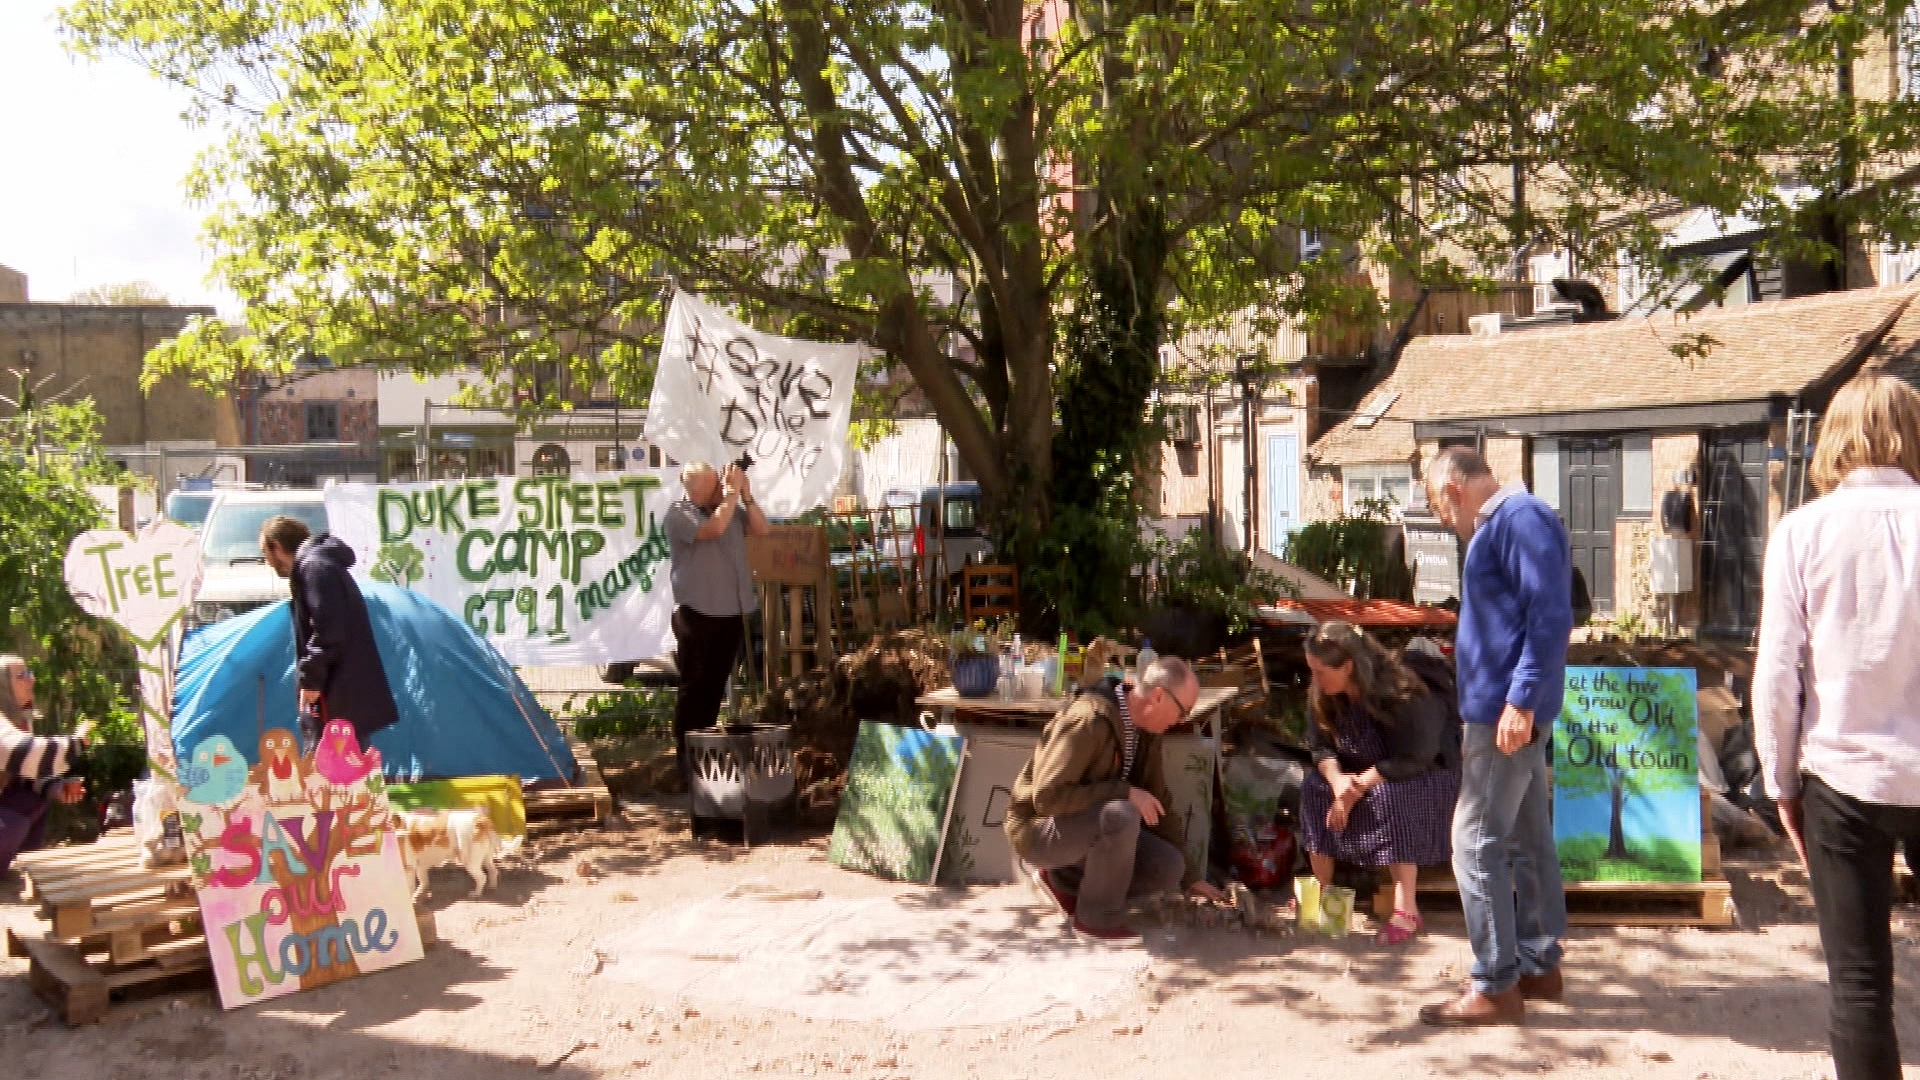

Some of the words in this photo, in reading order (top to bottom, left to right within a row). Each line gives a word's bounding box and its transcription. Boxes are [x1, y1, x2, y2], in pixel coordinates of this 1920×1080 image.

[377, 480, 499, 543] DUKE
[1564, 674, 1588, 692] et
[1592, 671, 1620, 693] the
[1577, 695, 1626, 713] grow
[1567, 719, 1582, 734] in
[1588, 718, 1619, 735] the
[1567, 736, 1619, 769] Old
[1628, 744, 1688, 770] town
[210, 804, 382, 888] SAVE
[224, 908, 399, 996] Home
